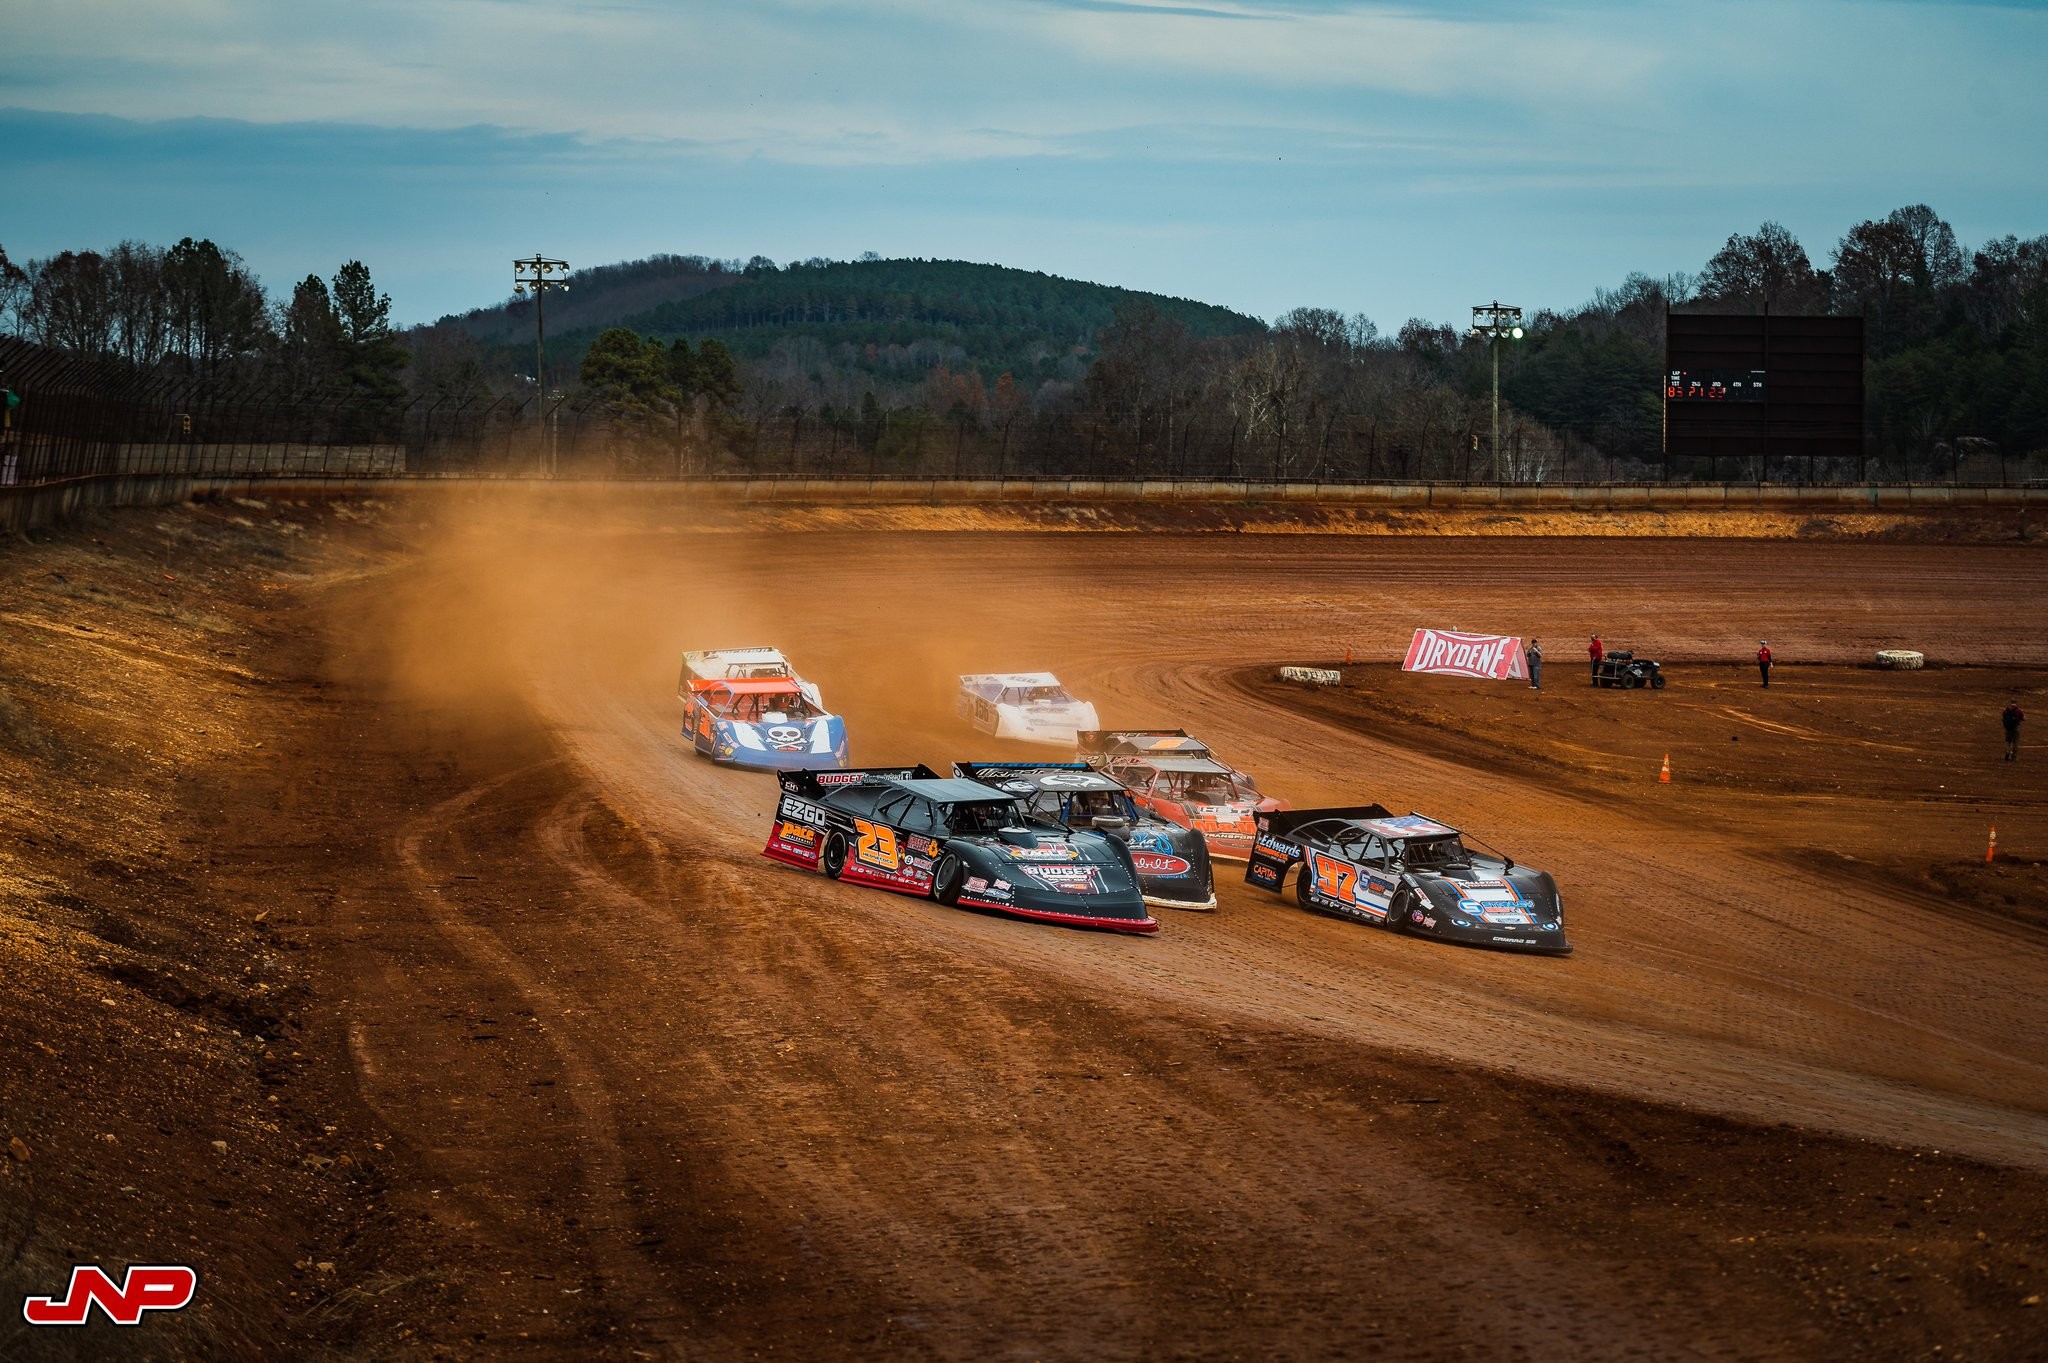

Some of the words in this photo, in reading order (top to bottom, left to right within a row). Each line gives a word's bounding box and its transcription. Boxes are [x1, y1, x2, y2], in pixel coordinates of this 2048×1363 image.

[1411, 629, 1511, 679] DRYDENE
[817, 773, 864, 785] BUDGET
[853, 818, 899, 870] 23
[1259, 834, 1301, 858] Edwards
[1026, 867, 1093, 876] BUDGET
[1253, 864, 1277, 880] CAPITAL
[1315, 854, 1357, 904] 97
